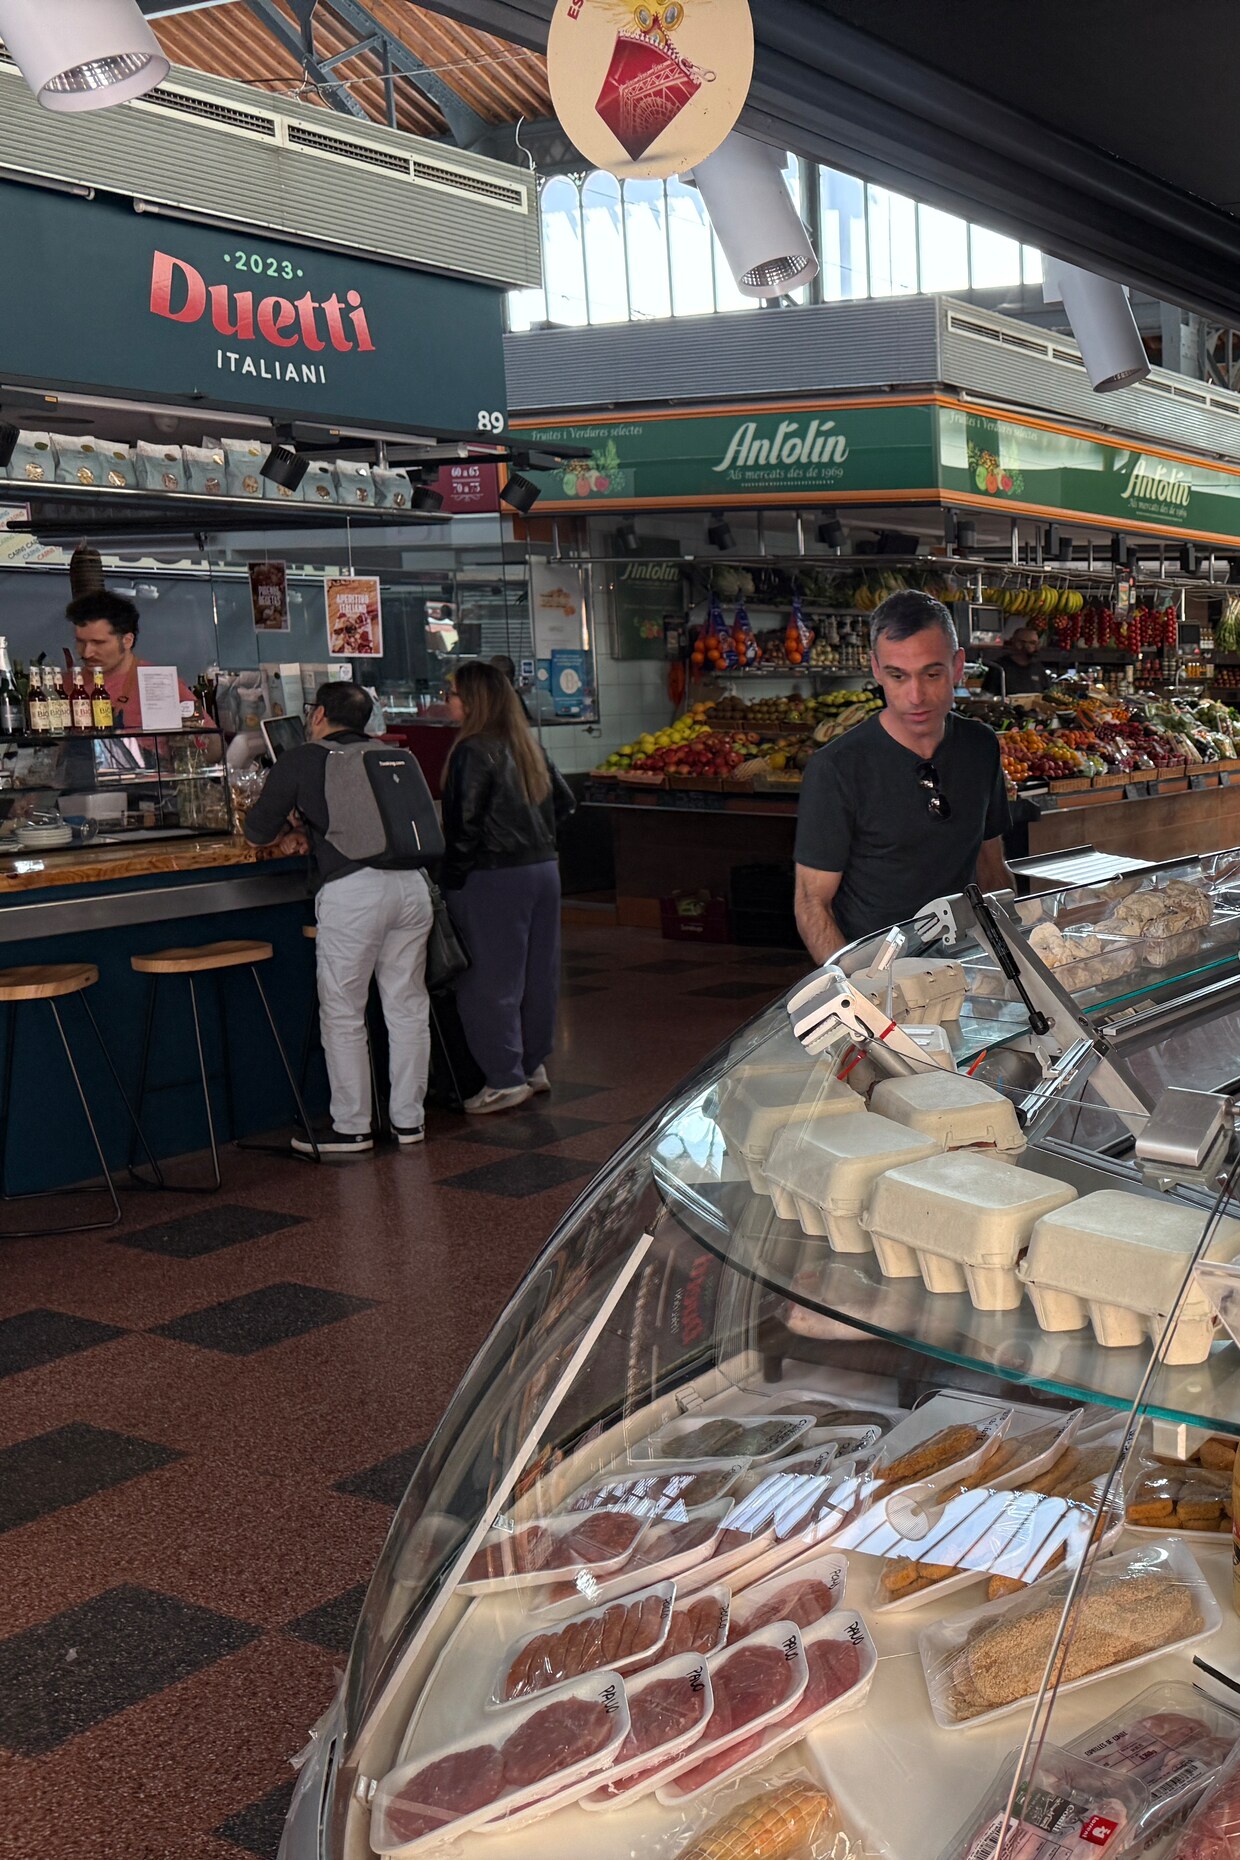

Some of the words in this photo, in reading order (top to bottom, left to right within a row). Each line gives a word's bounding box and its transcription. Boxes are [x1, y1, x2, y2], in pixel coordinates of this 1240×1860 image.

[235, 251, 293, 280] 2023
[150, 250, 377, 353] Duetti
[216, 349, 327, 384] ITALIANI
[477, 411, 504, 434] 89
[531, 429, 561, 441] Fruites
[568, 426, 608, 439] Verdures
[610, 424, 643, 437] selectes
[727, 469, 742, 480] Als
[745, 469, 785, 480] mercats
[787, 465, 803, 478] des
[806, 465, 819, 478] de
[821, 467, 844, 478] 1969
[843, 1620, 865, 1646] PAVO
[781, 1634, 800, 1662] PAVO
[686, 1665, 706, 1693] PAVO
[598, 1684, 620, 1714] PAVO
[1052, 1804, 1077, 1834] Conill
[1083, 1816, 1100, 1839] torrent
